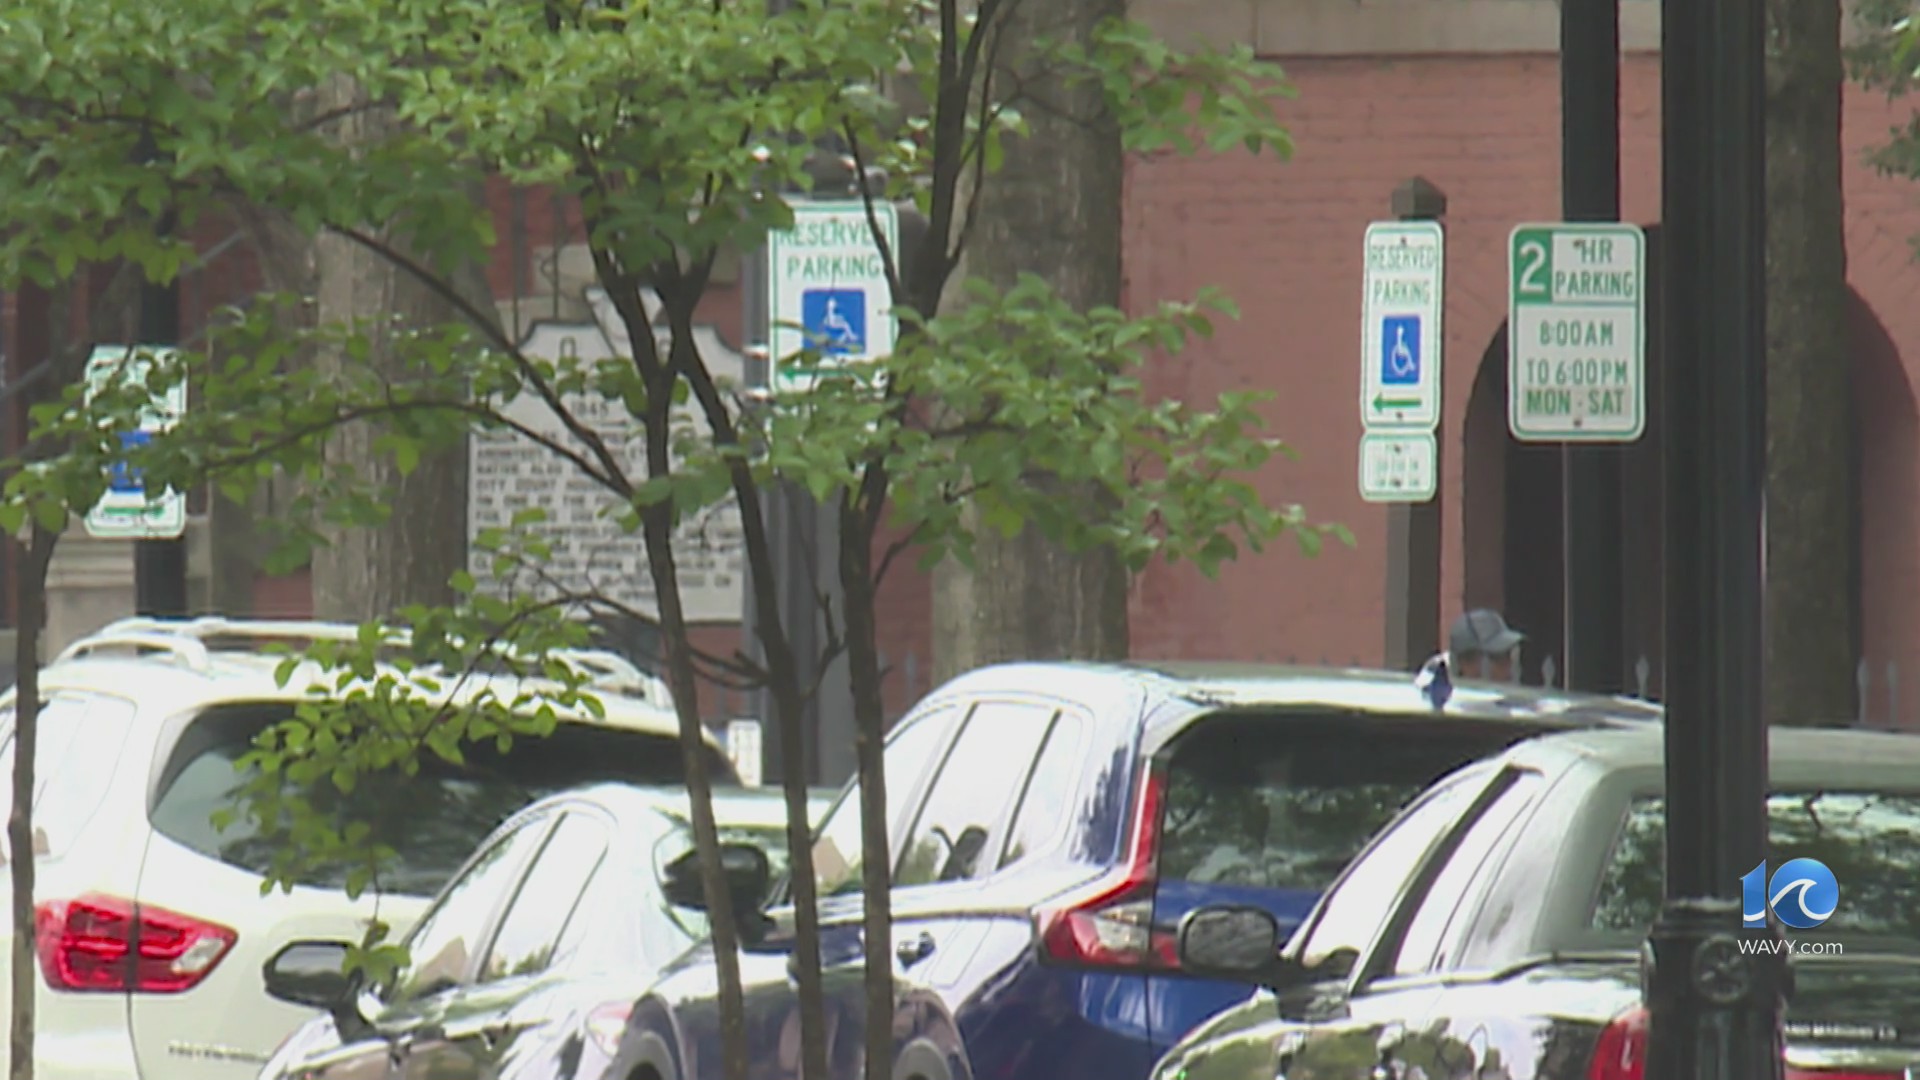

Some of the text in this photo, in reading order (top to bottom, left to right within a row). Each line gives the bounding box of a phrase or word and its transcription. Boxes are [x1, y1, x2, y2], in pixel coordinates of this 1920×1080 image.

[779, 222, 884, 246] RESERVE
[786, 254, 880, 279] PARKING
[1371, 244, 1436, 269] RESERVED
[1519, 239, 1614, 294] 2 HR
[1373, 279, 1431, 304] PARKING
[1555, 270, 1635, 297] PARKING
[1540, 319, 1614, 346] 8:00AM
[1527, 358, 1628, 385] TO 6:00PM
[1527, 388, 1571, 415] MON
[1588, 388, 1624, 415] SAT
